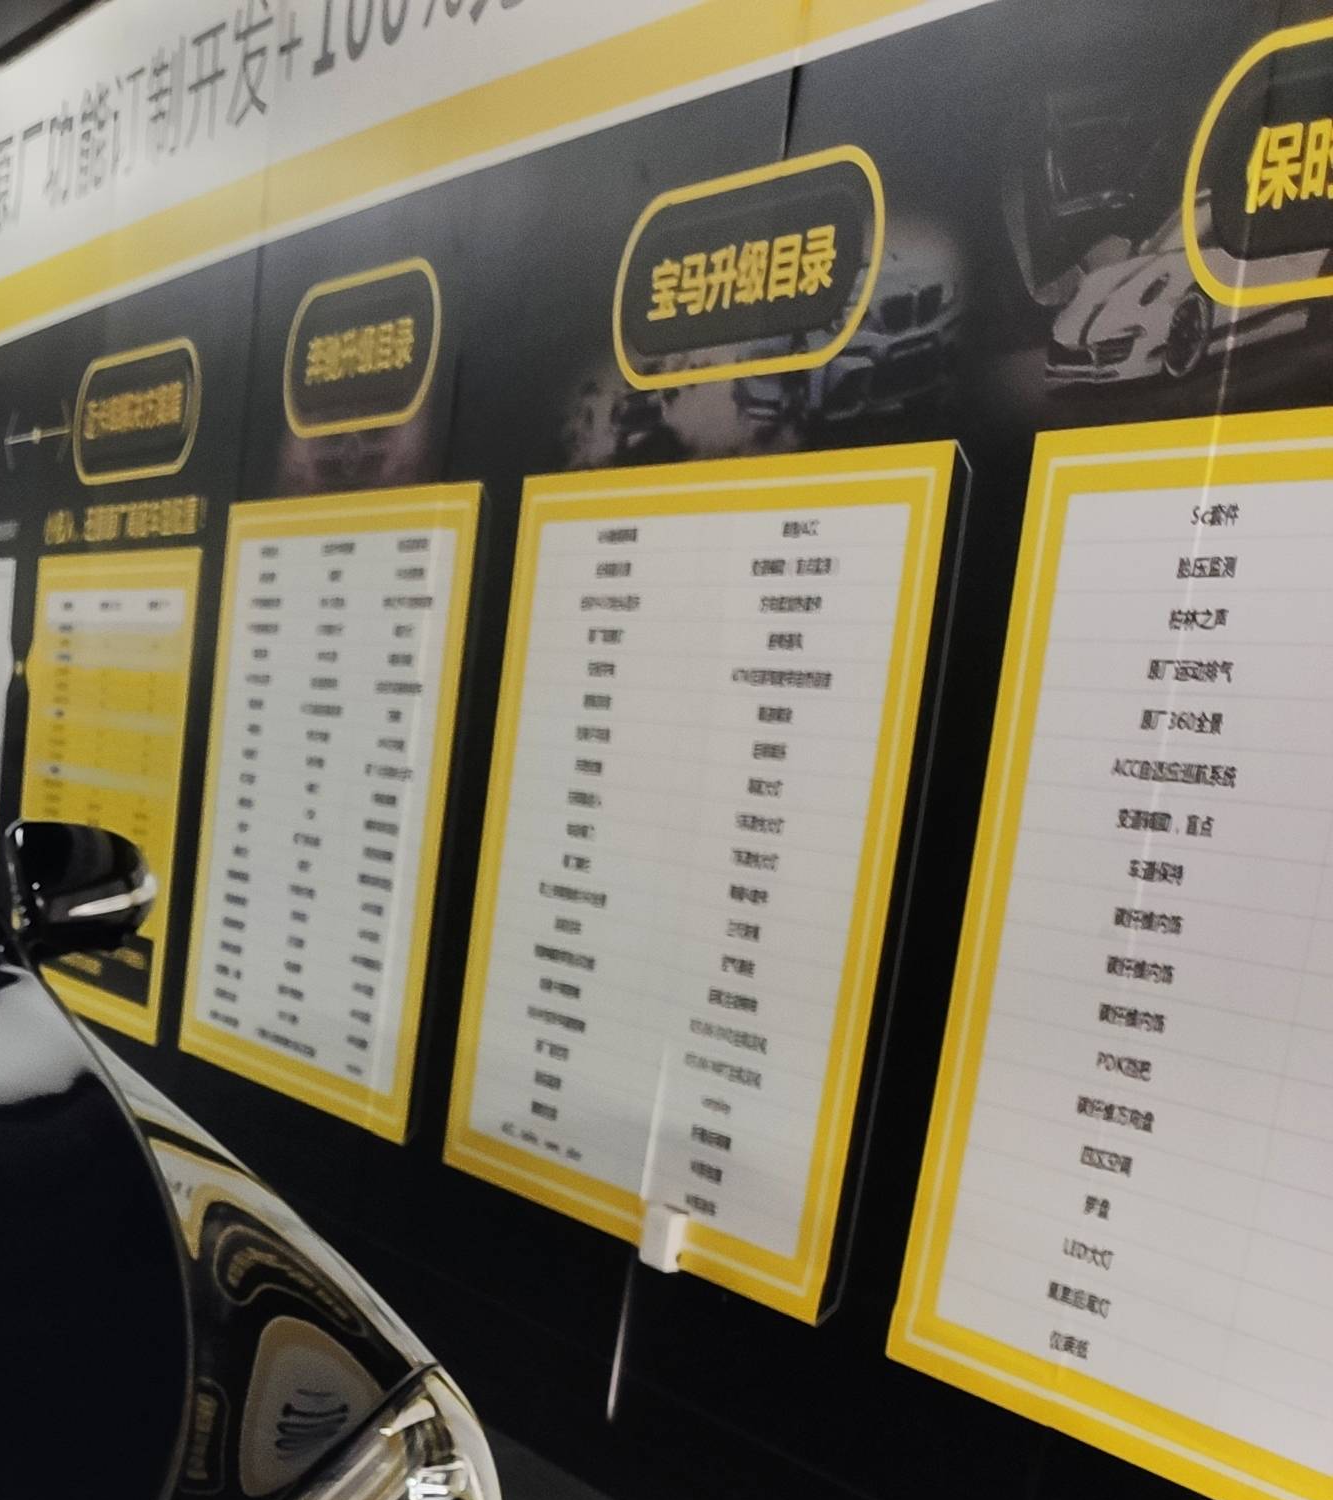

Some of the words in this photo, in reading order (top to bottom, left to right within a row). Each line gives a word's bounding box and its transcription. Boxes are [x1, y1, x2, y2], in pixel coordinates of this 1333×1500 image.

[646, 223, 838, 322] 宝马升级目录
